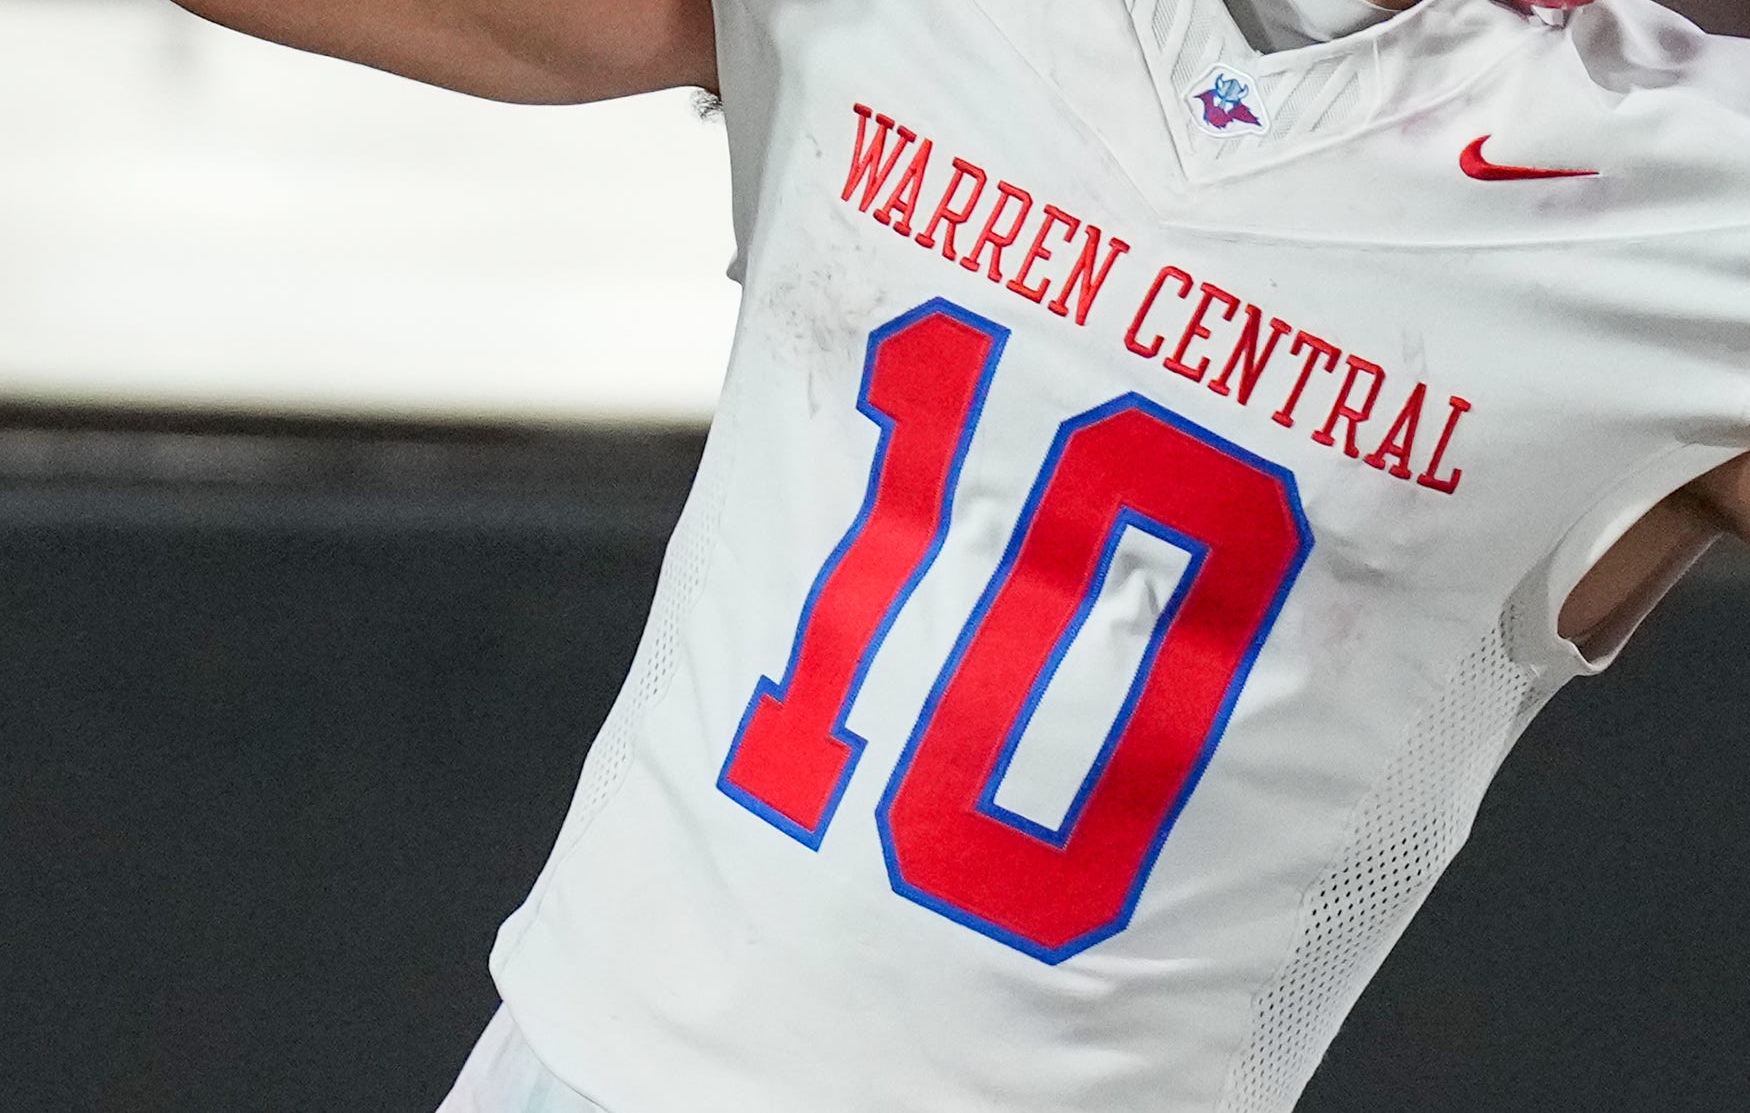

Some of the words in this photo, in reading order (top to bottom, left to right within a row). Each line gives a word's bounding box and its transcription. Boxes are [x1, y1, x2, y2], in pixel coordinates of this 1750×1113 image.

[840, 102, 1131, 326] WARREN
[1123, 265, 1472, 495] CENTRAL
[716, 296, 1315, 966] 10
